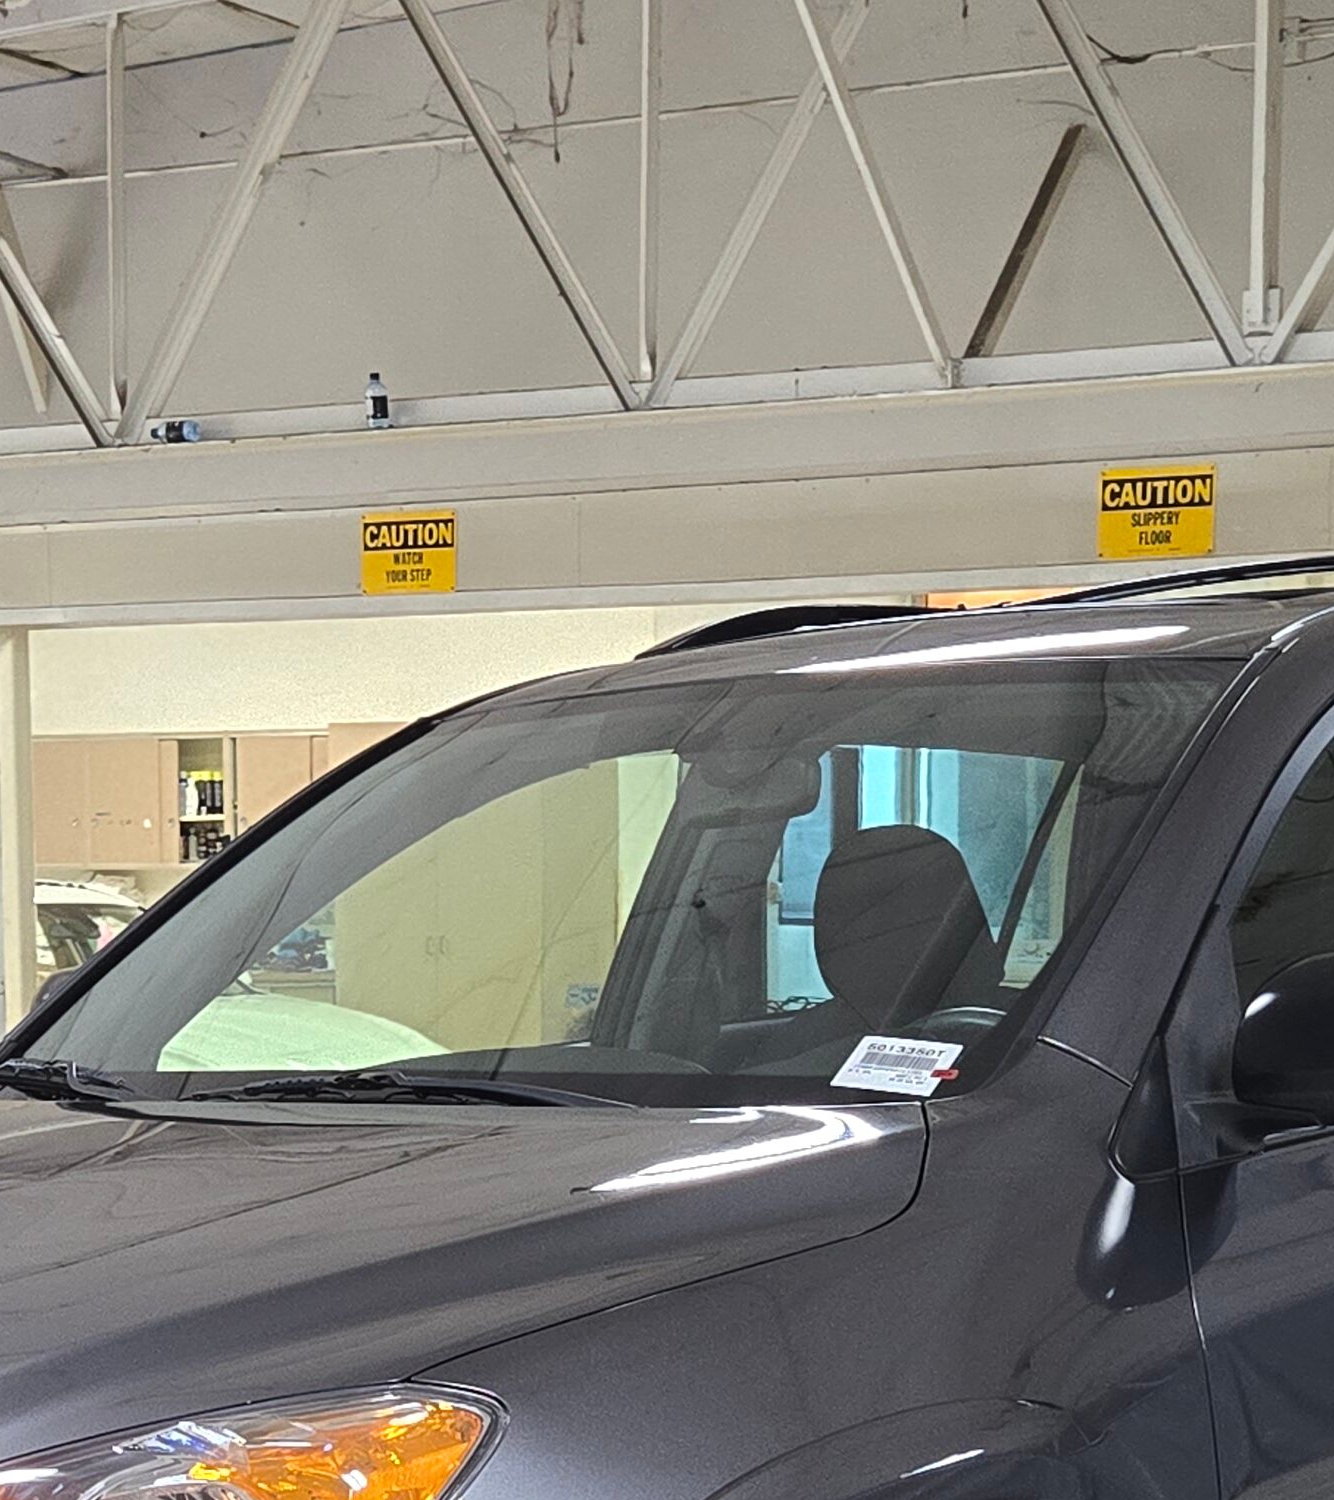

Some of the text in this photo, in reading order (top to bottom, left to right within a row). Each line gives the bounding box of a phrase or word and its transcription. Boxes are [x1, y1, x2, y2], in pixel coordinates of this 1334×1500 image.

[1103, 478, 1211, 507] CAUTION
[1130, 511, 1181, 528] SLIPPERY
[365, 522, 453, 548] CAUTION
[1139, 530, 1172, 546] FLOOR
[393, 552, 424, 565] WATCH
[385, 568, 432, 583] YOUR STEP
